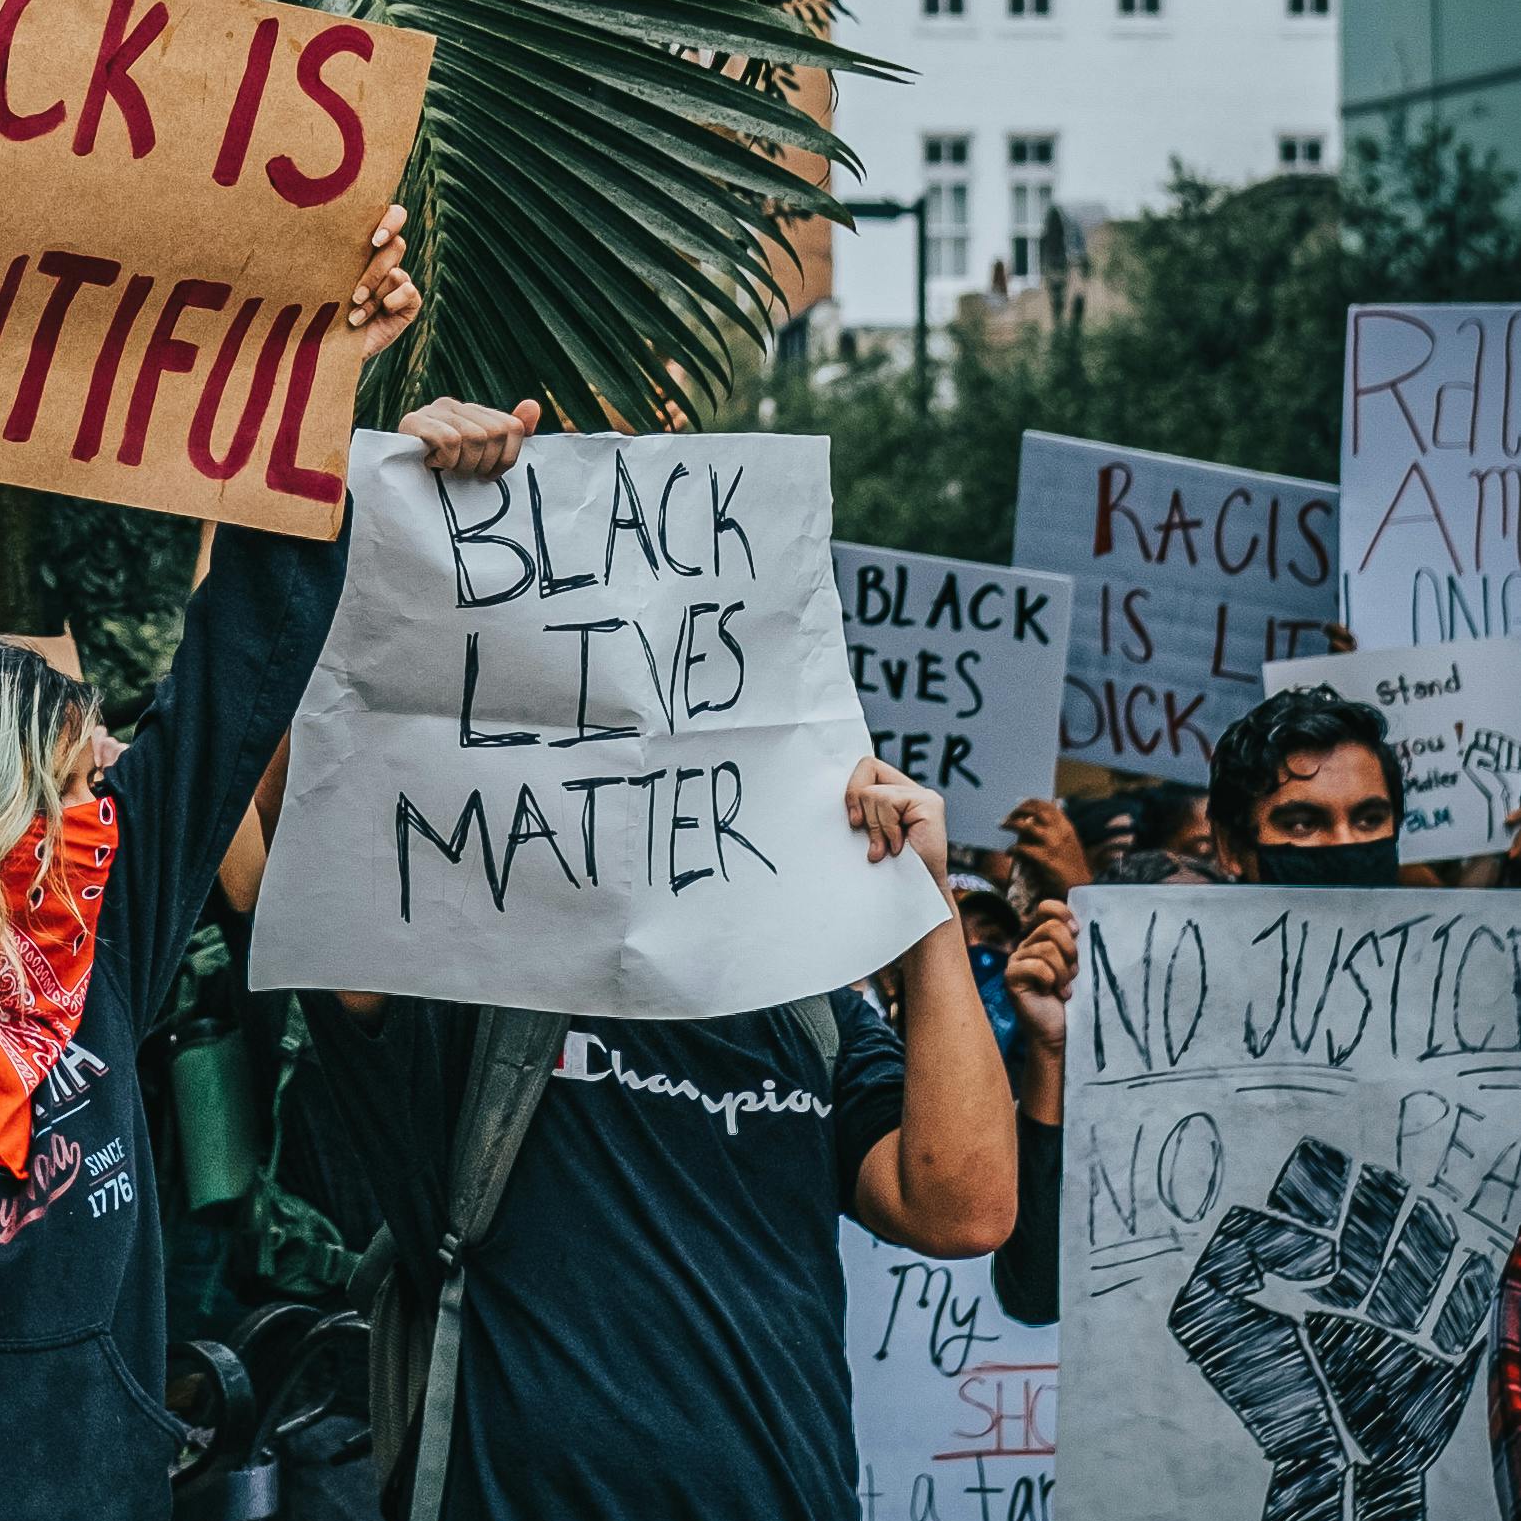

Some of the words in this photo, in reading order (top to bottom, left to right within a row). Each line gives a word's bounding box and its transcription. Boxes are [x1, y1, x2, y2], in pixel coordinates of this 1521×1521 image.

[212, 17, 374, 209] IS
[433, 449, 756, 609] BLACK
[1093, 461, 1334, 587] RACIS
[856, 564, 1050, 646] BLACK
[1100, 583, 1154, 665] IS
[459, 601, 746, 748] LIVES
[849, 644, 984, 720] IVES
[394, 760, 778, 923] MATTER
[1089, 910, 1207, 1072] NO
[1244, 909, 1521, 1067] JUSTIC
[84, 1136, 127, 1177] SINCE
[87, 1172, 134, 1219] 1776
[1088, 1112, 1224, 1245] NO
[873, 1262, 1001, 1378] My
